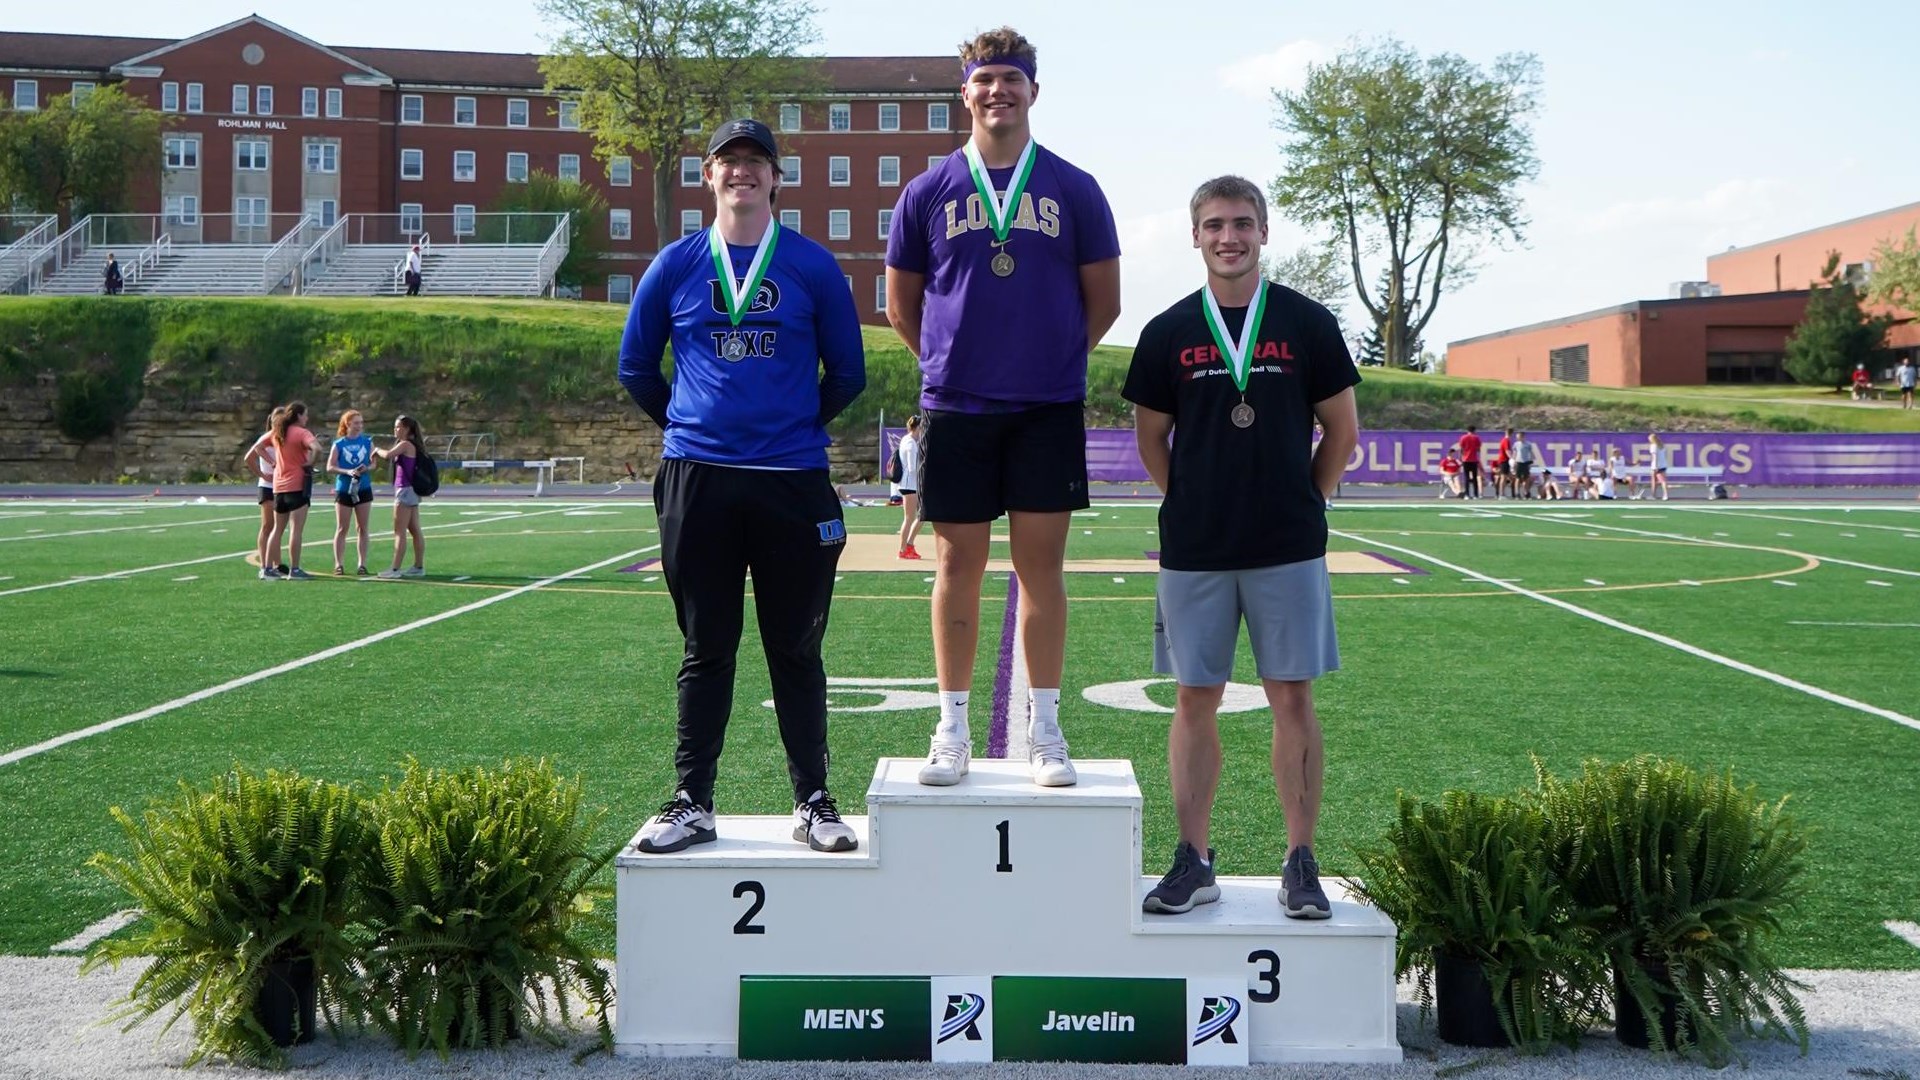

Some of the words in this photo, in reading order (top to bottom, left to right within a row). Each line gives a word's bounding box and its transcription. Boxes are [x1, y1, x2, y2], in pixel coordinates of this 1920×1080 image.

[218, 119, 261, 128] ROHLMAN
[265, 121, 287, 129] HALL
[996, 819, 1013, 873] 1
[732, 880, 766, 935] 2
[1247, 949, 1281, 1004] 3
[803, 1008, 885, 1030] MEN'S
[1041, 1010, 1136, 1033] Javelin
